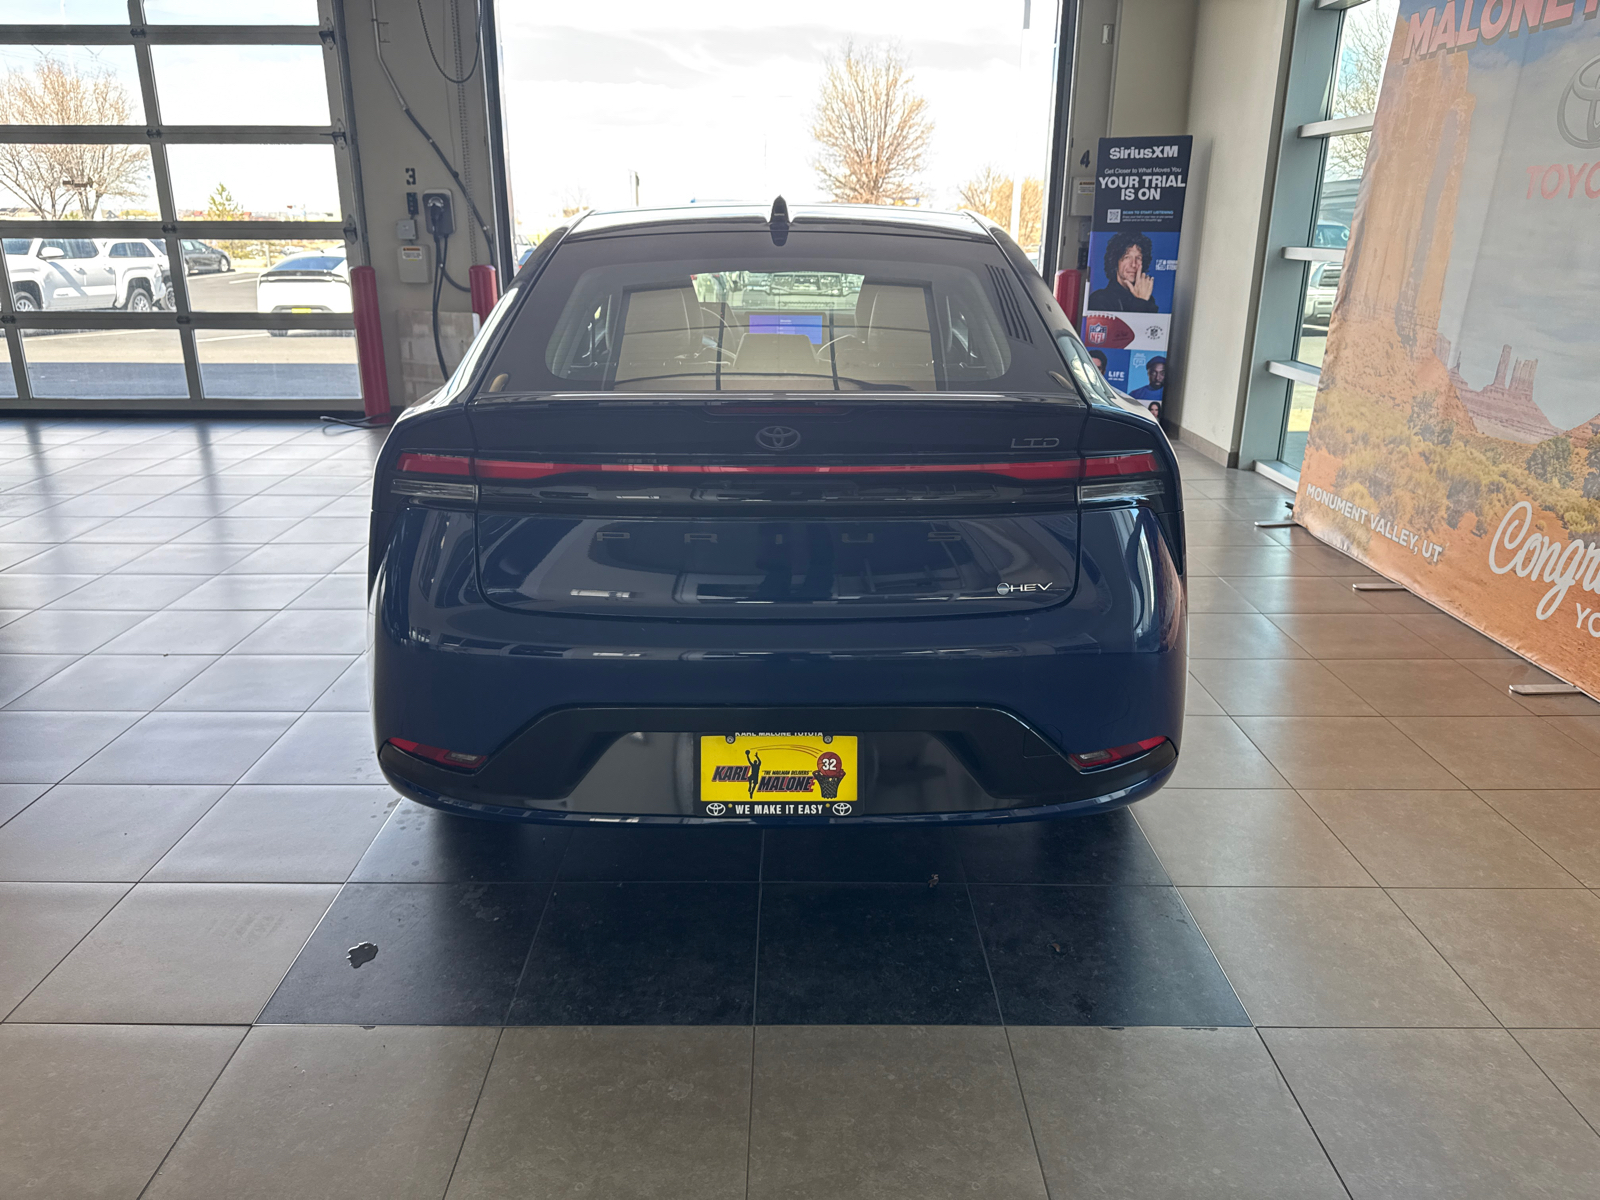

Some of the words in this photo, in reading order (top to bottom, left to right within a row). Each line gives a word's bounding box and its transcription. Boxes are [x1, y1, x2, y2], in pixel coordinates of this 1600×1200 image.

[1080, 149, 1090, 168] 4
[1109, 145, 1179, 160] SiriusXM
[405, 168, 416, 185] 3
[1099, 176, 1139, 189] YOUR
[1142, 175, 1186, 188] TRIAL
[1121, 189, 1135, 200] IS
[1138, 188, 1161, 200] ON
[1090, 332, 1105, 343] NFL
[1011, 438, 1060, 448] LTD
[1306, 483, 1368, 524] MONUMENT
[1370, 513, 1419, 555] VALLEY,
[1422, 540, 1443, 562] UT
[1010, 582, 1053, 592] HEV
[822, 759, 836, 771] 32
[712, 765, 751, 782] KARL
[757, 776, 815, 792] MALONE
[735, 804, 750, 814] WE
[754, 804, 782, 814] MAKE
[785, 804, 794, 814] IT
[799, 804, 823, 814] EASY
